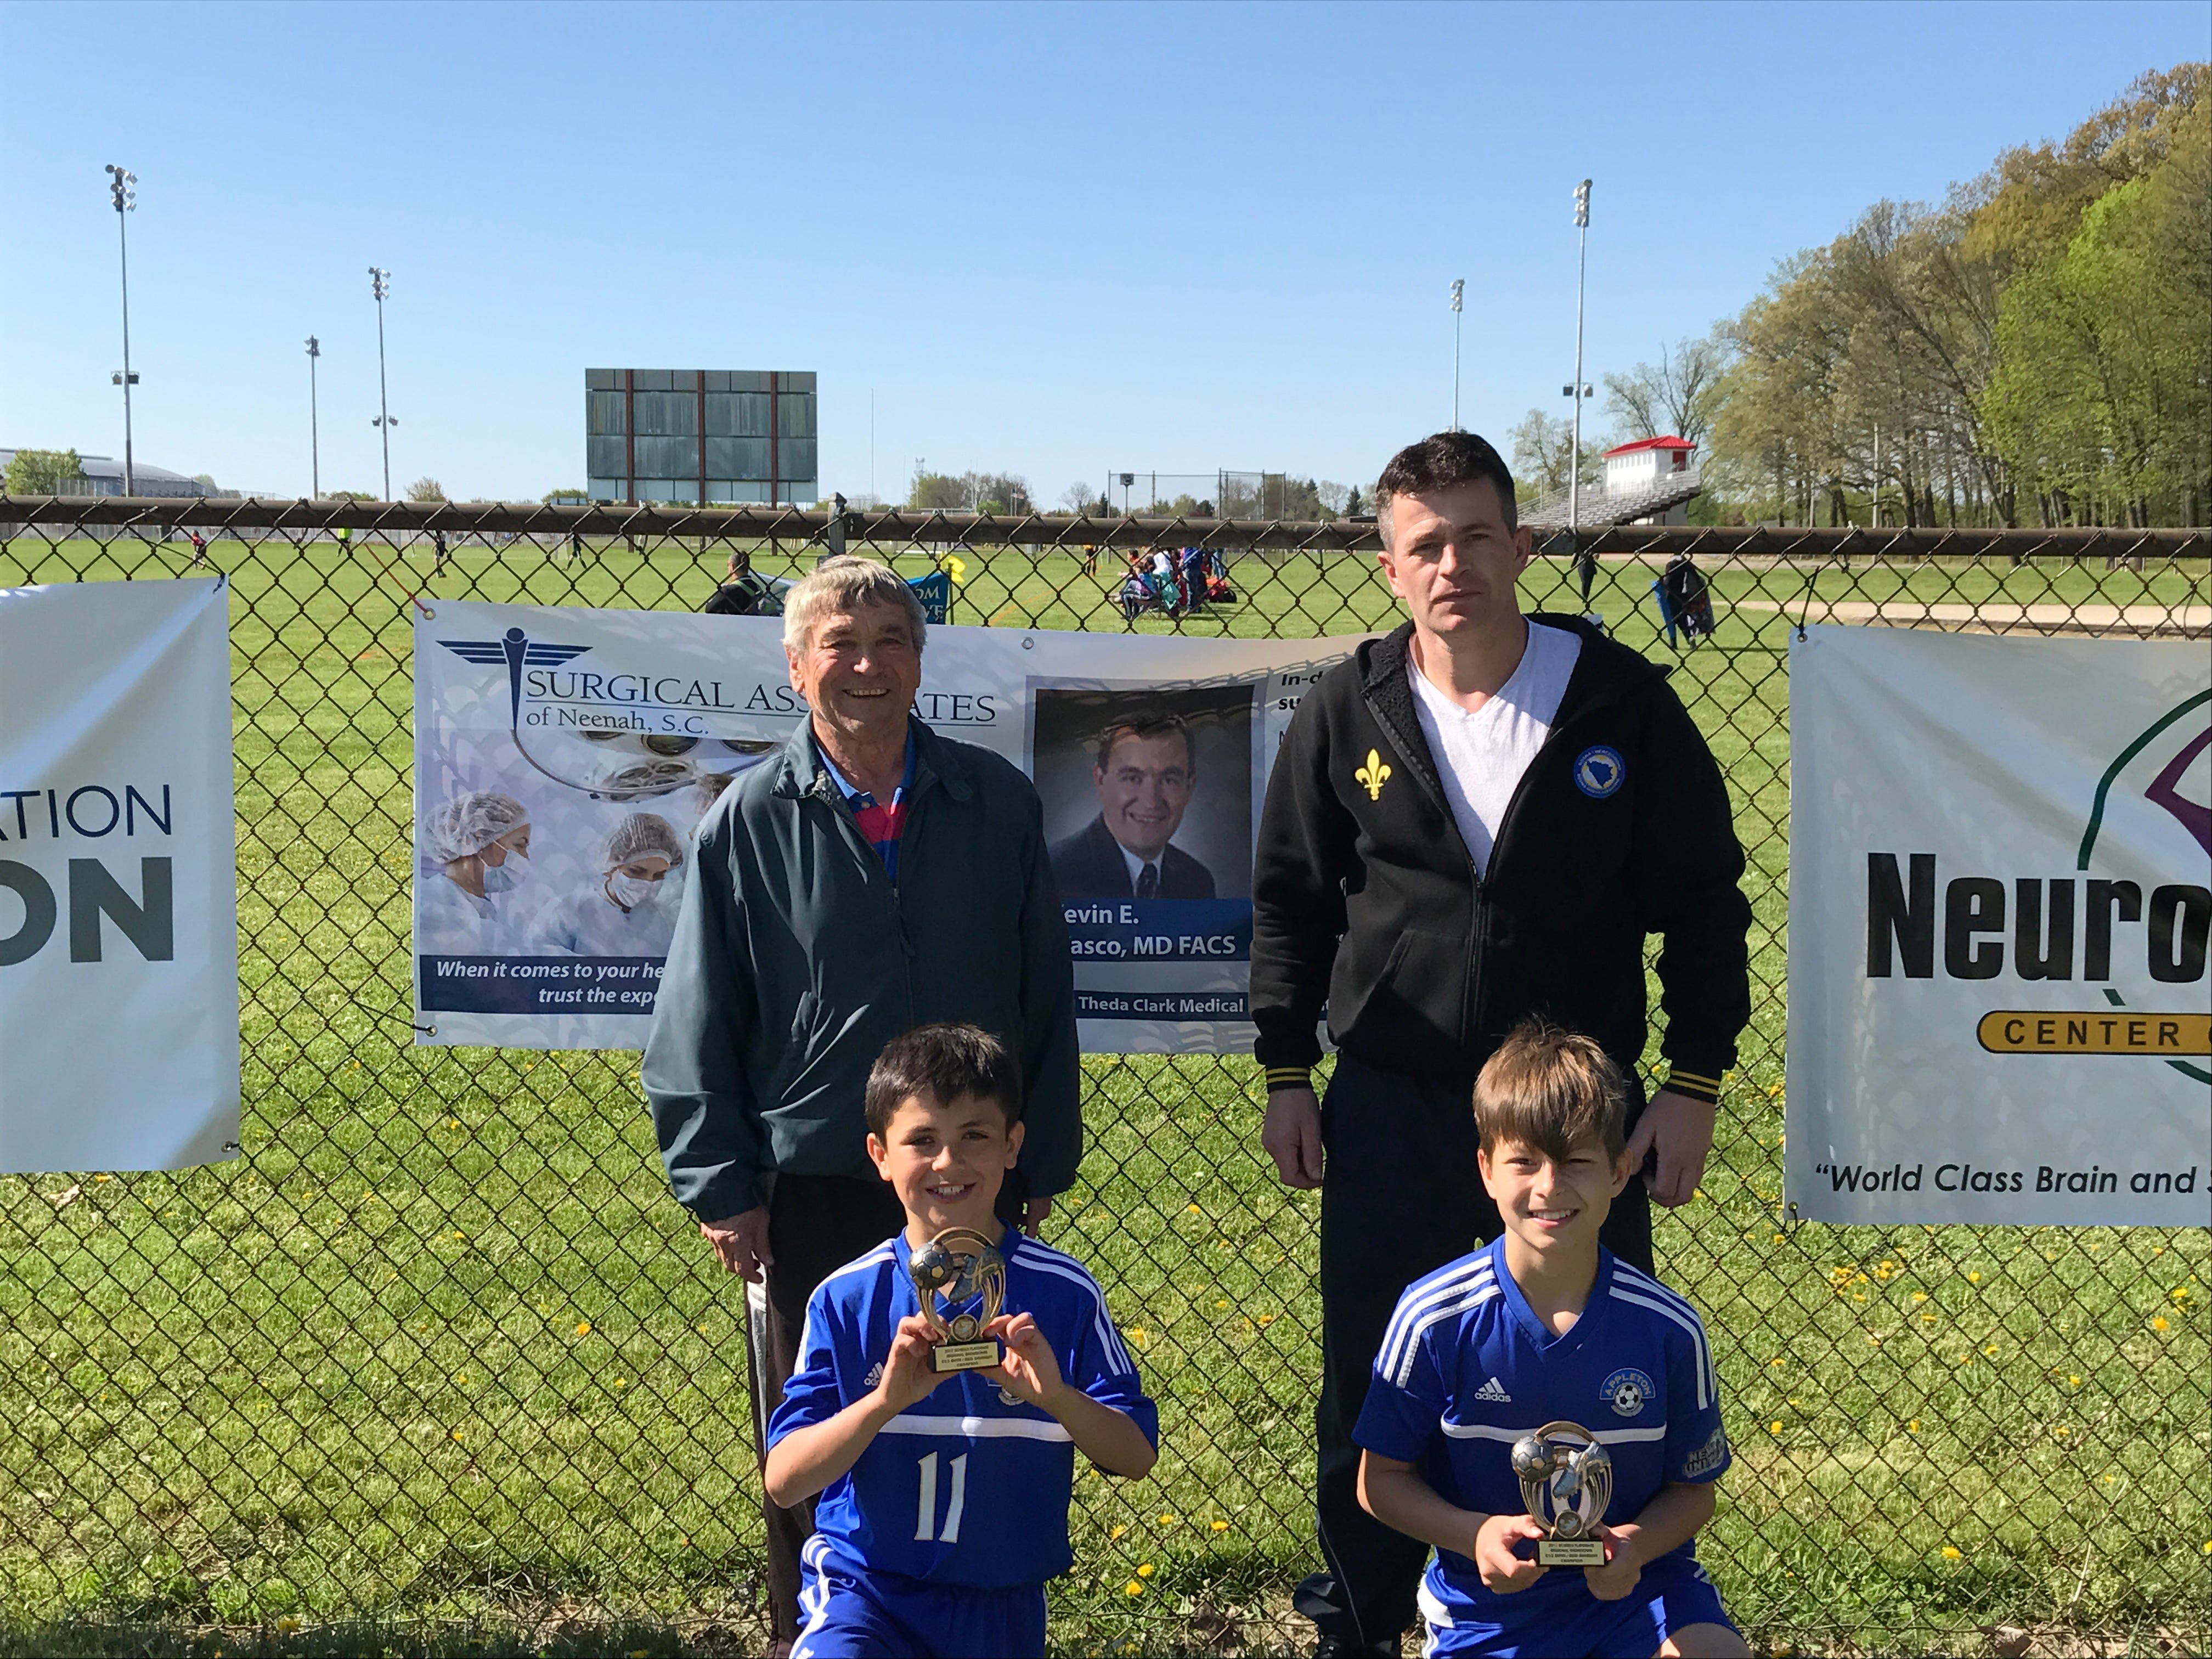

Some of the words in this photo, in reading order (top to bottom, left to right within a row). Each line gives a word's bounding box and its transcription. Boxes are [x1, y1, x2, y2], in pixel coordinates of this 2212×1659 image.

[527, 670, 735, 709] SURGICAL
[744, 684, 996, 722] ASATES
[527, 707, 549, 726] of
[557, 708, 653, 734] Neenah,
[662, 714, 709, 735] S.C.
[0, 784, 172, 841] TION
[1064, 904, 1113, 924] evin
[1120, 905, 1139, 924] E.
[1867, 853, 2211, 983] Neuro
[1070, 939, 1127, 958] asco,
[1133, 936, 1172, 955] MD
[1179, 935, 1237, 955] FACS
[437, 961, 489, 978] When
[493, 961, 507, 978] it
[510, 966, 569, 978] comes
[573, 964, 591, 978] to
[595, 967, 639, 983] your
[539, 988, 582, 1003] trust
[587, 988, 616, 1003] the
[620, 991, 656, 1007] exp
[1079, 996, 1128, 1011] Theda
[1133, 997, 1175, 1012] Clark
[1180, 998, 1243, 1013] Medical
[2004, 1019, 2180, 1046] CENTER
[1934, 1164, 2023, 1193] Class
[2036, 1165, 2117, 1193] Brain
[2130, 1166, 2197, 1194] and
[1605, 1373, 1651, 1396] APPLETON
[1474, 1392, 1511, 1403] adidas
[914, 1451, 967, 1543] 11
